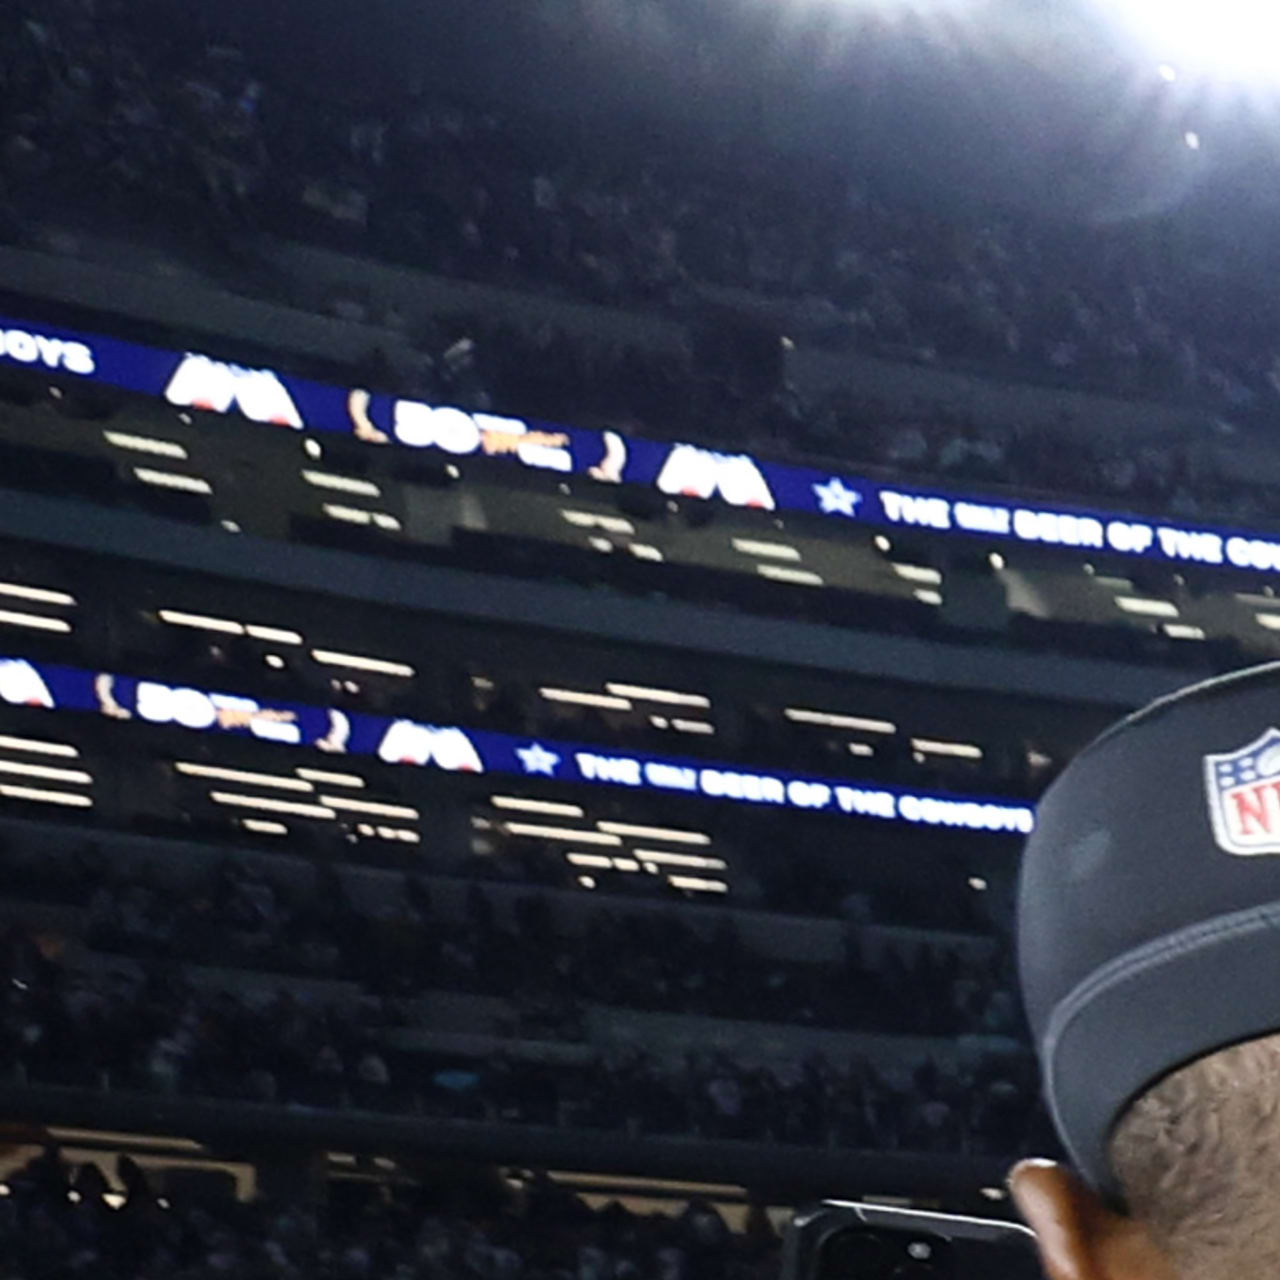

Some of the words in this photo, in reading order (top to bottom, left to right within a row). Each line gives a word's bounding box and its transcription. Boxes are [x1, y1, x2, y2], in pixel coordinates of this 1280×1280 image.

[879, 491, 950, 529] THE
[1157, 527, 1223, 563] THE
[576, 753, 641, 785] THE
[835, 786, 895, 818] THE
